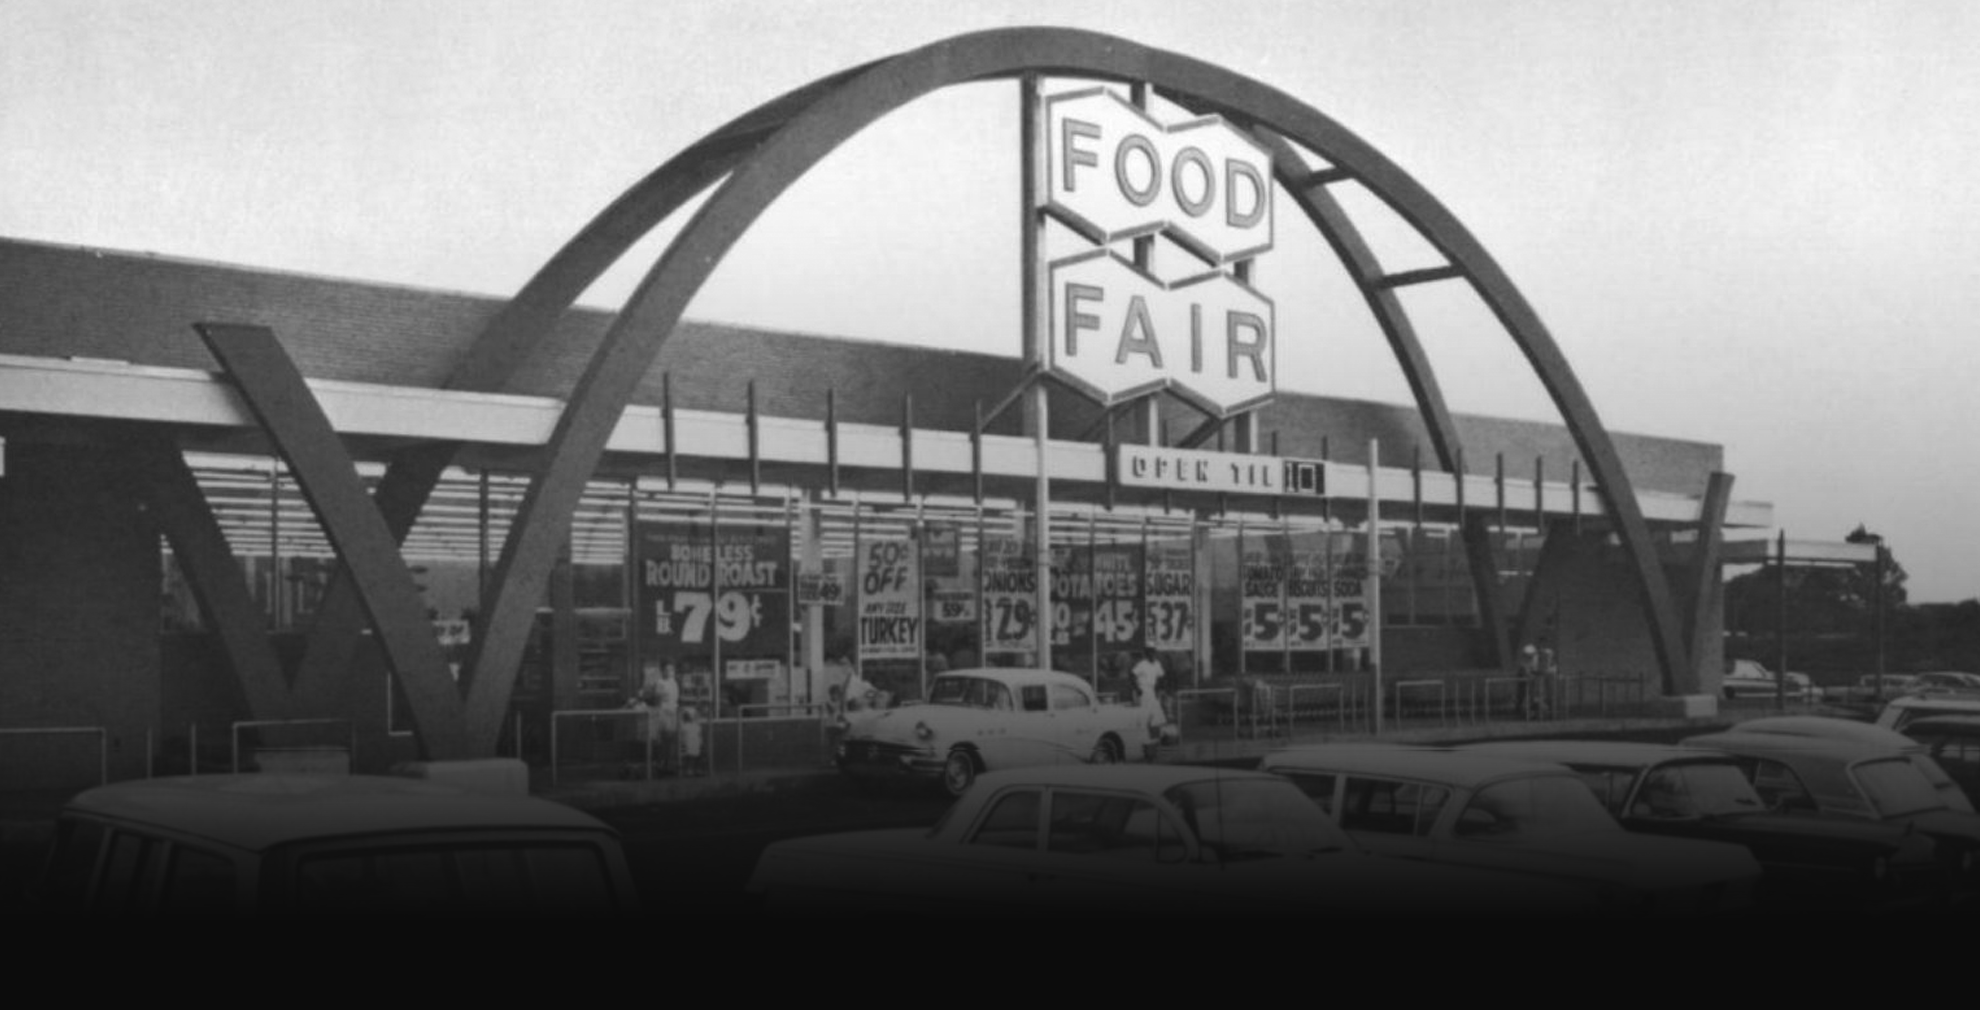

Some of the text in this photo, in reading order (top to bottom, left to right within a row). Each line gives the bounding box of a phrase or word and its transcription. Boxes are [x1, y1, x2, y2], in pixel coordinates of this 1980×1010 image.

[1061, 117, 1267, 229] FOOD
[1064, 282, 1268, 383] FAIR
[1131, 456, 1317, 494] OPEN TIL 10
[645, 560, 711, 588] ROUND
[717, 560, 778, 587] ROAST
[864, 566, 908, 596] OFF
[1146, 573, 1192, 597] SUGAR
[861, 617, 918, 645] TURKEY
